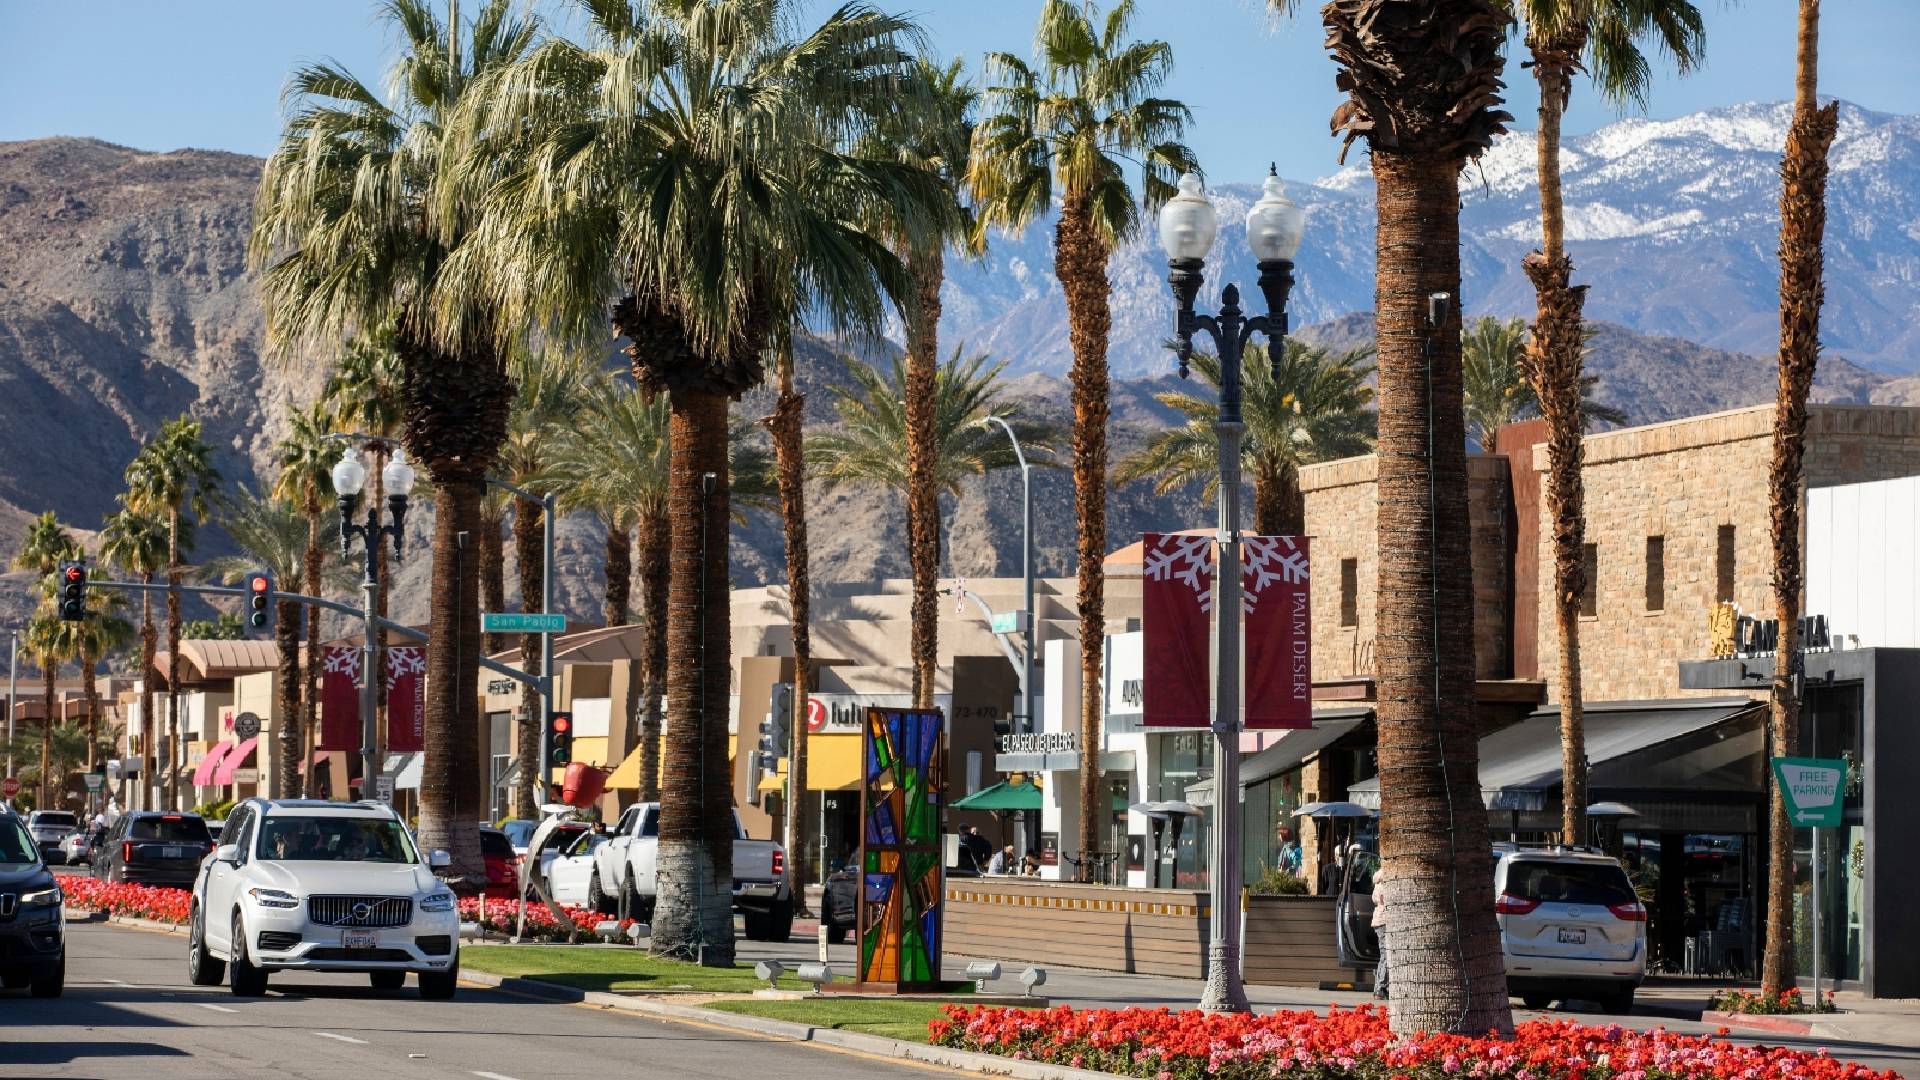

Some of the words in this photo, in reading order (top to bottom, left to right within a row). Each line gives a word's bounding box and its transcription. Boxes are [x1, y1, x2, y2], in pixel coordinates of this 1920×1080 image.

[1293, 592, 1306, 635] PALM
[491, 615, 516, 627] San
[523, 615, 559, 627] Pablo
[1293, 641, 1307, 702] DESERT
[1800, 771, 1828, 782] FREE
[1794, 784, 1835, 797] PARKING
